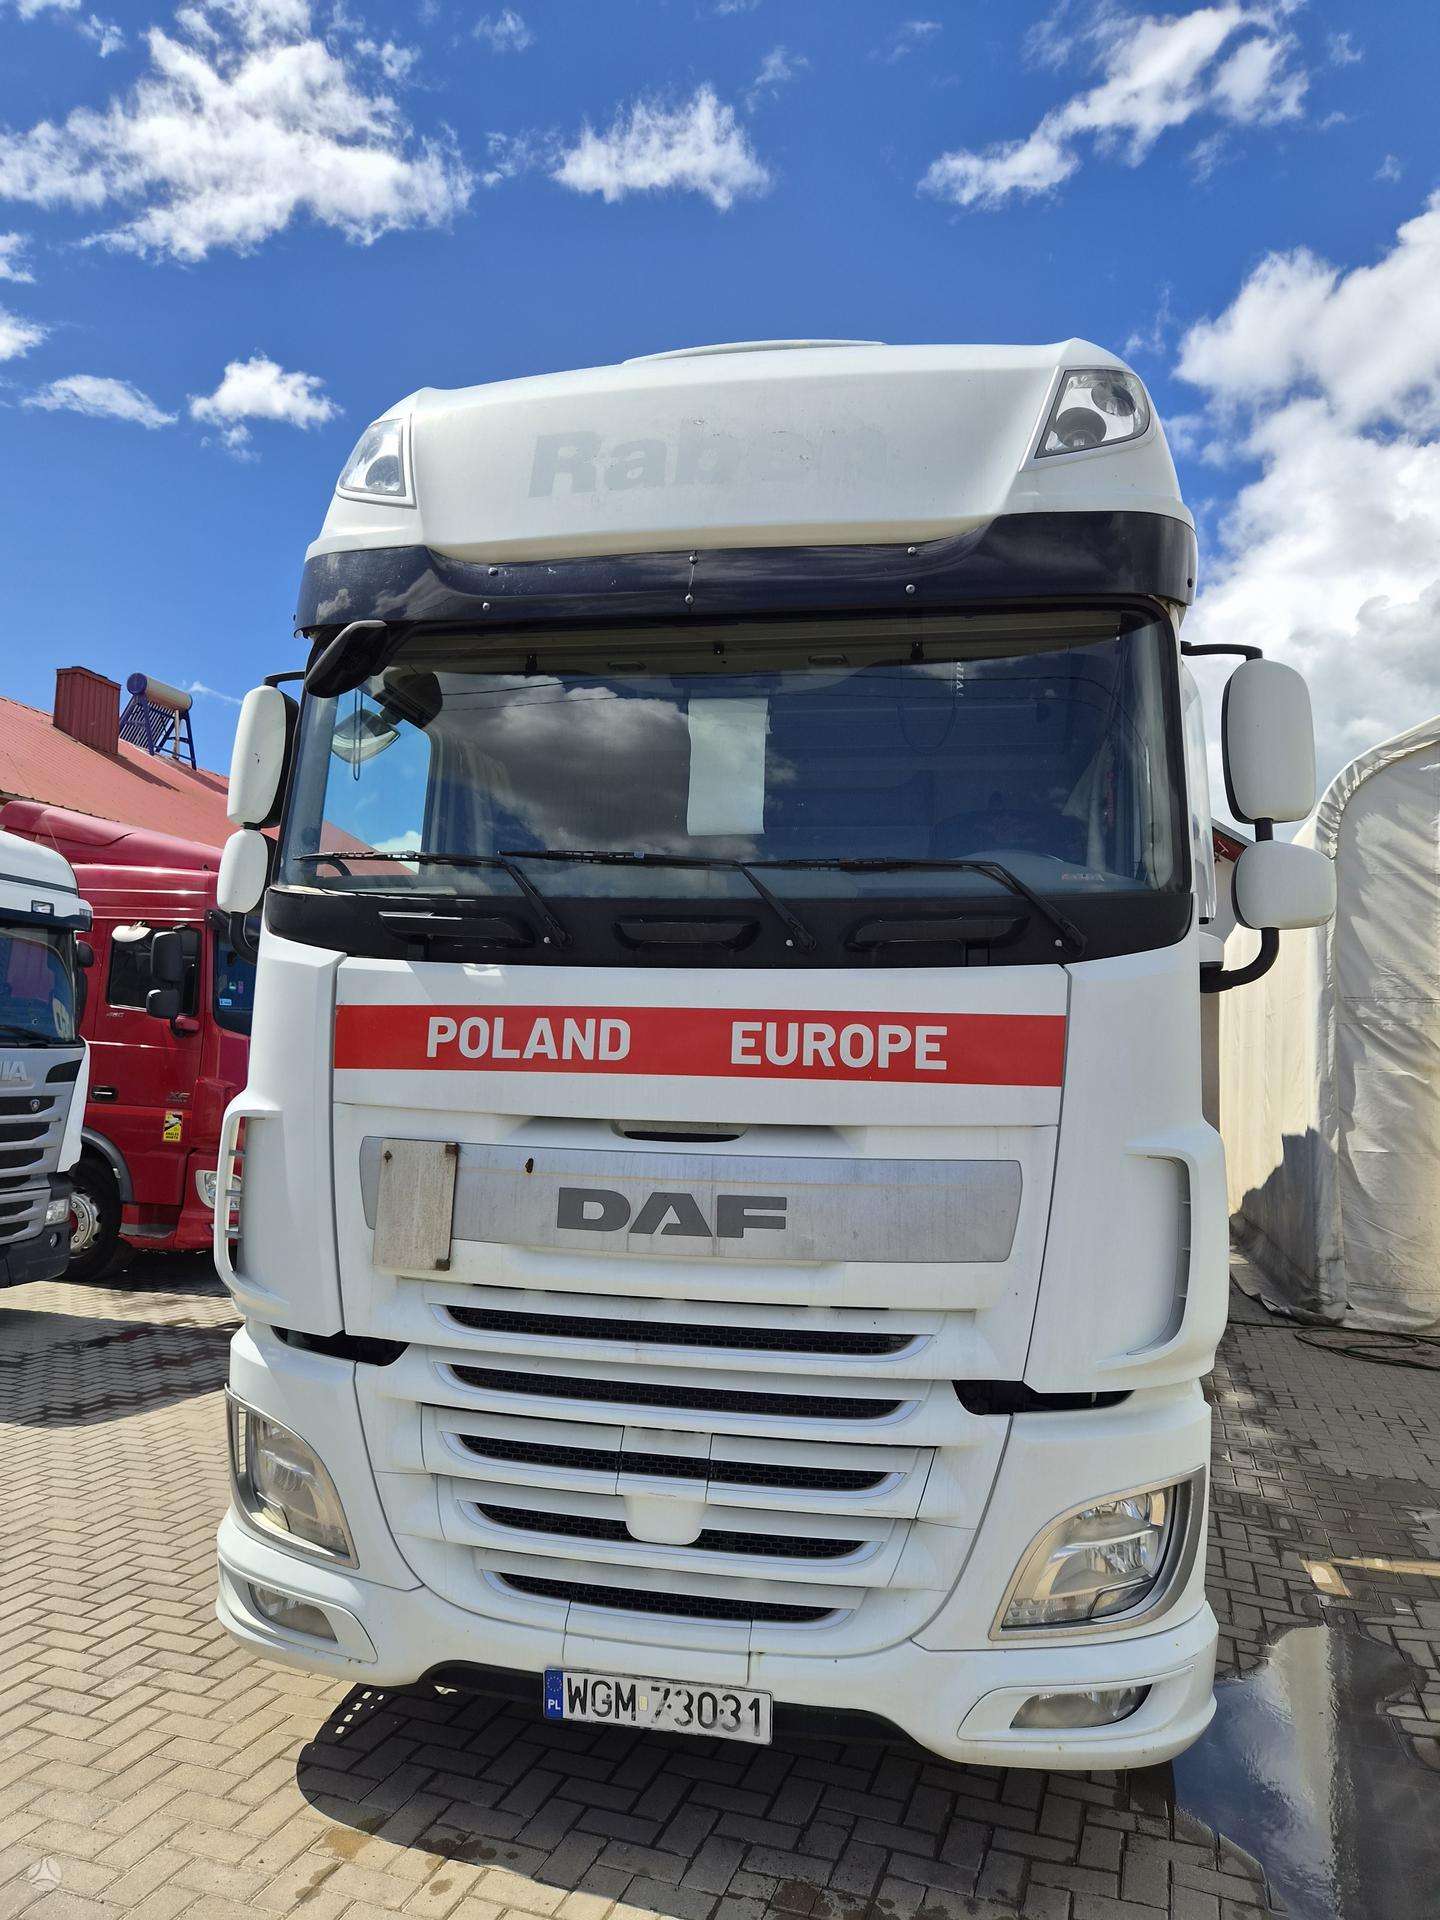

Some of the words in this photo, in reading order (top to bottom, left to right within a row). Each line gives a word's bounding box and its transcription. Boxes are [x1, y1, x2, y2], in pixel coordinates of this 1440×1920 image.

[426, 1016, 632, 1062] POLAND
[730, 1021, 948, 1071] EUROPE
[556, 1187, 788, 1239] DAF
[547, 1699, 562, 1711] PL
[567, 1677, 637, 1722] WGM
[650, 1686, 761, 1737] 73031
